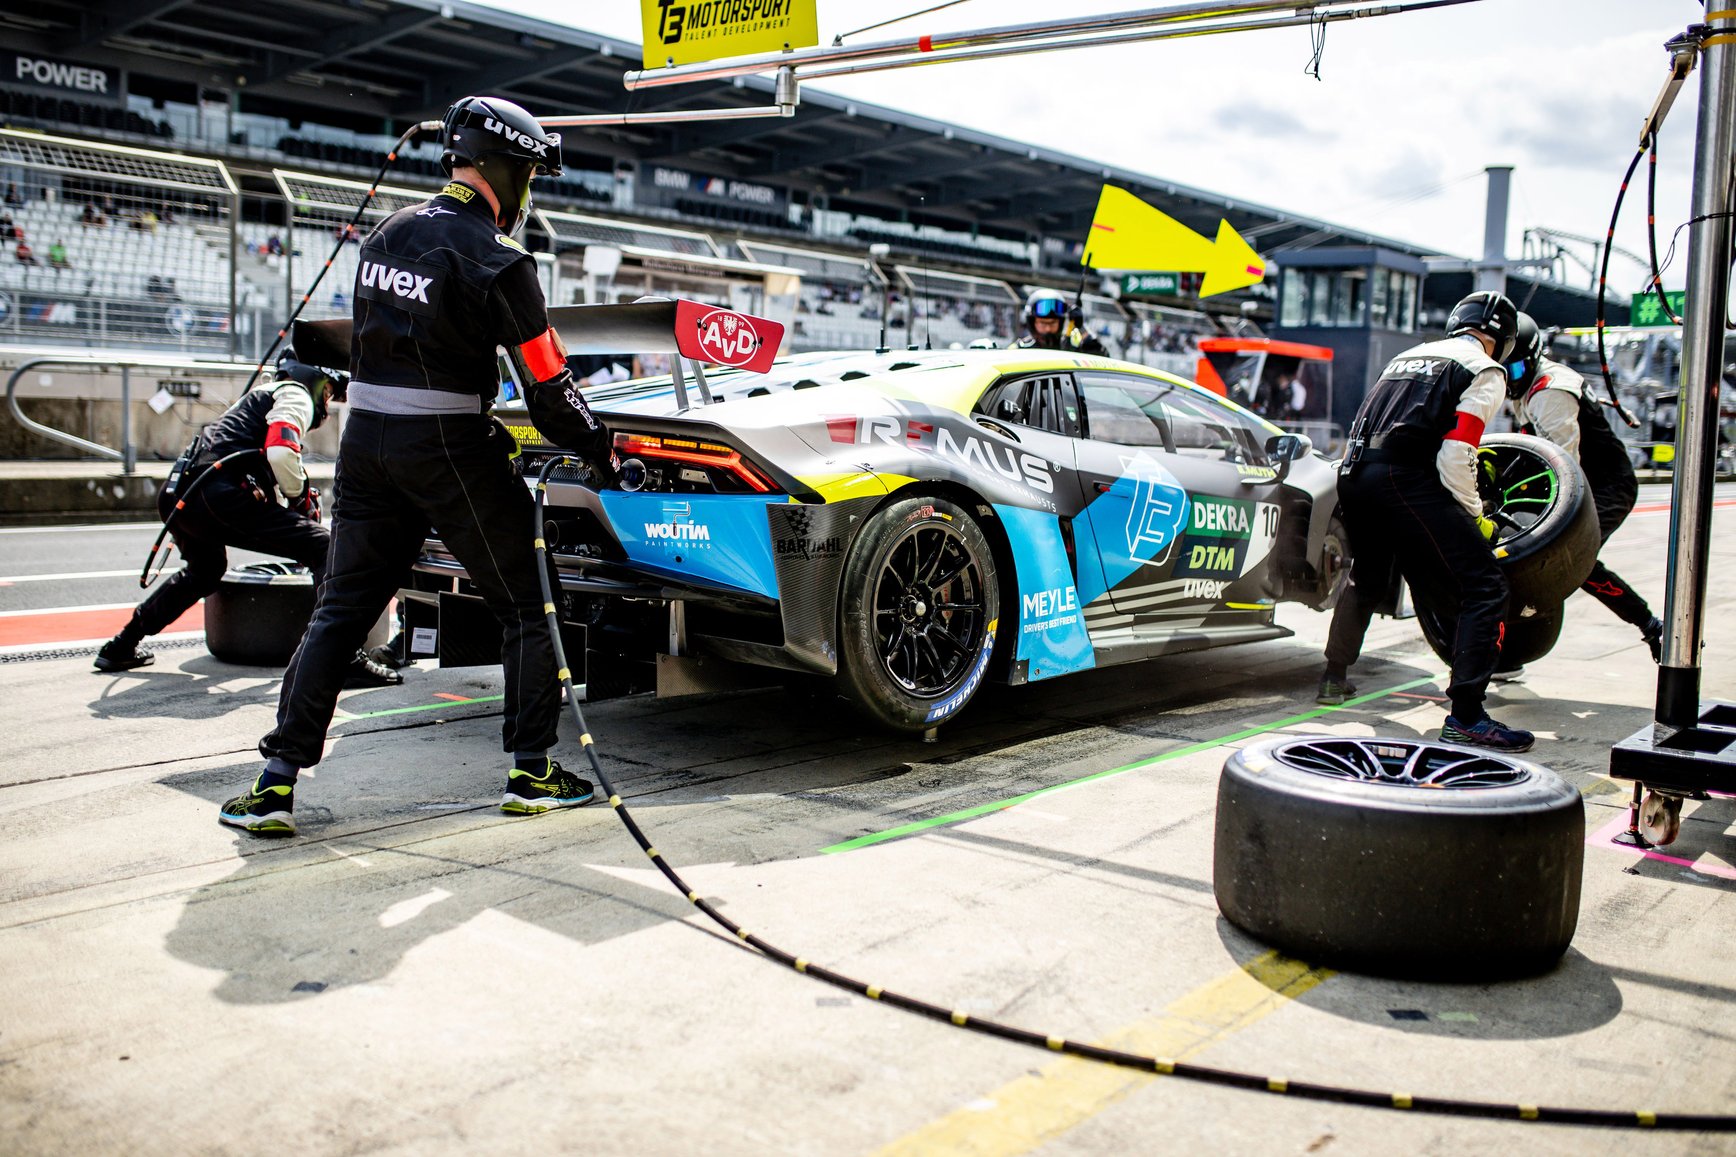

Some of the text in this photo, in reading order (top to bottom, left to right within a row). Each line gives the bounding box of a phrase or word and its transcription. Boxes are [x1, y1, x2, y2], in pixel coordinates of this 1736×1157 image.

[685, 18, 791, 42] TALENT DEVELOPMENT
[686, 0, 793, 30] MOTORSPORT
[16, 56, 108, 94] POWER
[483, 117, 548, 157] uvex
[728, 181, 776, 204] POWER
[361, 261, 434, 304] uvex
[703, 321, 756, 359] AvD
[860, 415, 1054, 494] REMUS
[1193, 501, 1250, 533] DEKRA
[1262, 505, 1279, 539] 10
[645, 540, 711, 549] PAINTWORKS
[1188, 544, 1235, 571] DTM
[1023, 585, 1076, 620] MEYLE
[1183, 579, 1224, 599] uvex
[932, 652, 989, 718] MICHELIN
